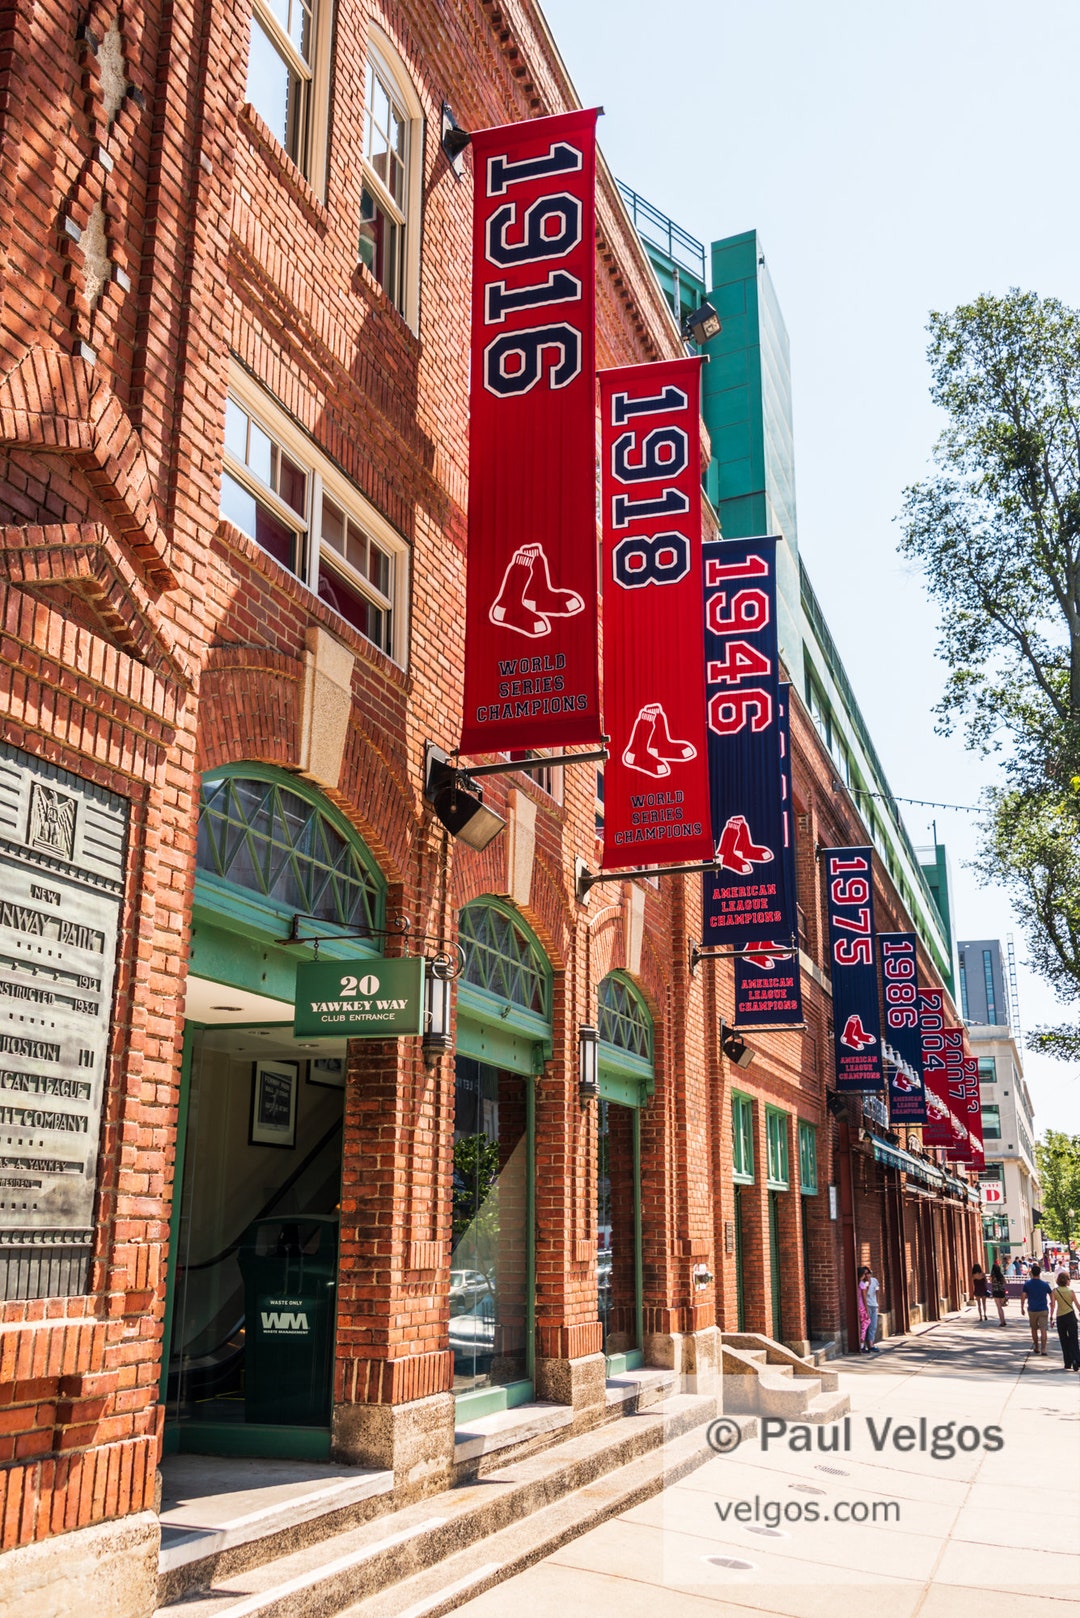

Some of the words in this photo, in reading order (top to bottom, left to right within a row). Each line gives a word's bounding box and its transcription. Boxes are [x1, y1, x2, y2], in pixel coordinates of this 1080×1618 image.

[483, 141, 583, 398] 1916
[611, 385, 691, 590] 1918
[705, 555, 772, 735] 1946
[498, 653, 566, 676] WORLD
[499, 675, 565, 698] SERIES
[476, 694, 588, 722] CHAMPIONS
[631, 790, 684, 808] WORLD
[632, 807, 683, 825] SERIES
[615, 823, 702, 845] CHAMPIONS
[34, 886, 58, 904] NEW
[712, 883, 776, 900] AMERICAN
[721, 898, 768, 913] LEAGUE
[830, 856, 873, 966] 1975
[0, 900, 51, 937] NWAY
[60, 920, 98, 951] PARK
[709, 910, 782, 928] CHAMPIONS
[339, 974, 380, 997] 20
[741, 976, 794, 990] AMERICAN
[883, 941, 918, 1029] 1986
[748, 989, 787, 1001] LEAGUE
[75, 999, 96, 1014] 1934
[310, 1000, 373, 1013] YAWKEY
[376, 999, 409, 1010] WAY
[738, 1000, 798, 1013] CHAMPIONS
[321, 1014, 346, 1022] CLUB
[349, 1013, 396, 1021] ENTRANCE
[918, 994, 946, 1072] 2004
[840, 1056, 878, 1064] AMERICAN
[845, 1064, 873, 1072] LEAGUE
[945, 1033, 966, 1100] 2007
[839, 1072, 880, 1080] CHAMPIONS
[37, 1076, 88, 1100] LEAGUE
[23, 1109, 85, 1132] COMPANY
[29, 1160, 67, 1172] YAWKEY
[986, 1189, 1001, 1202] D
